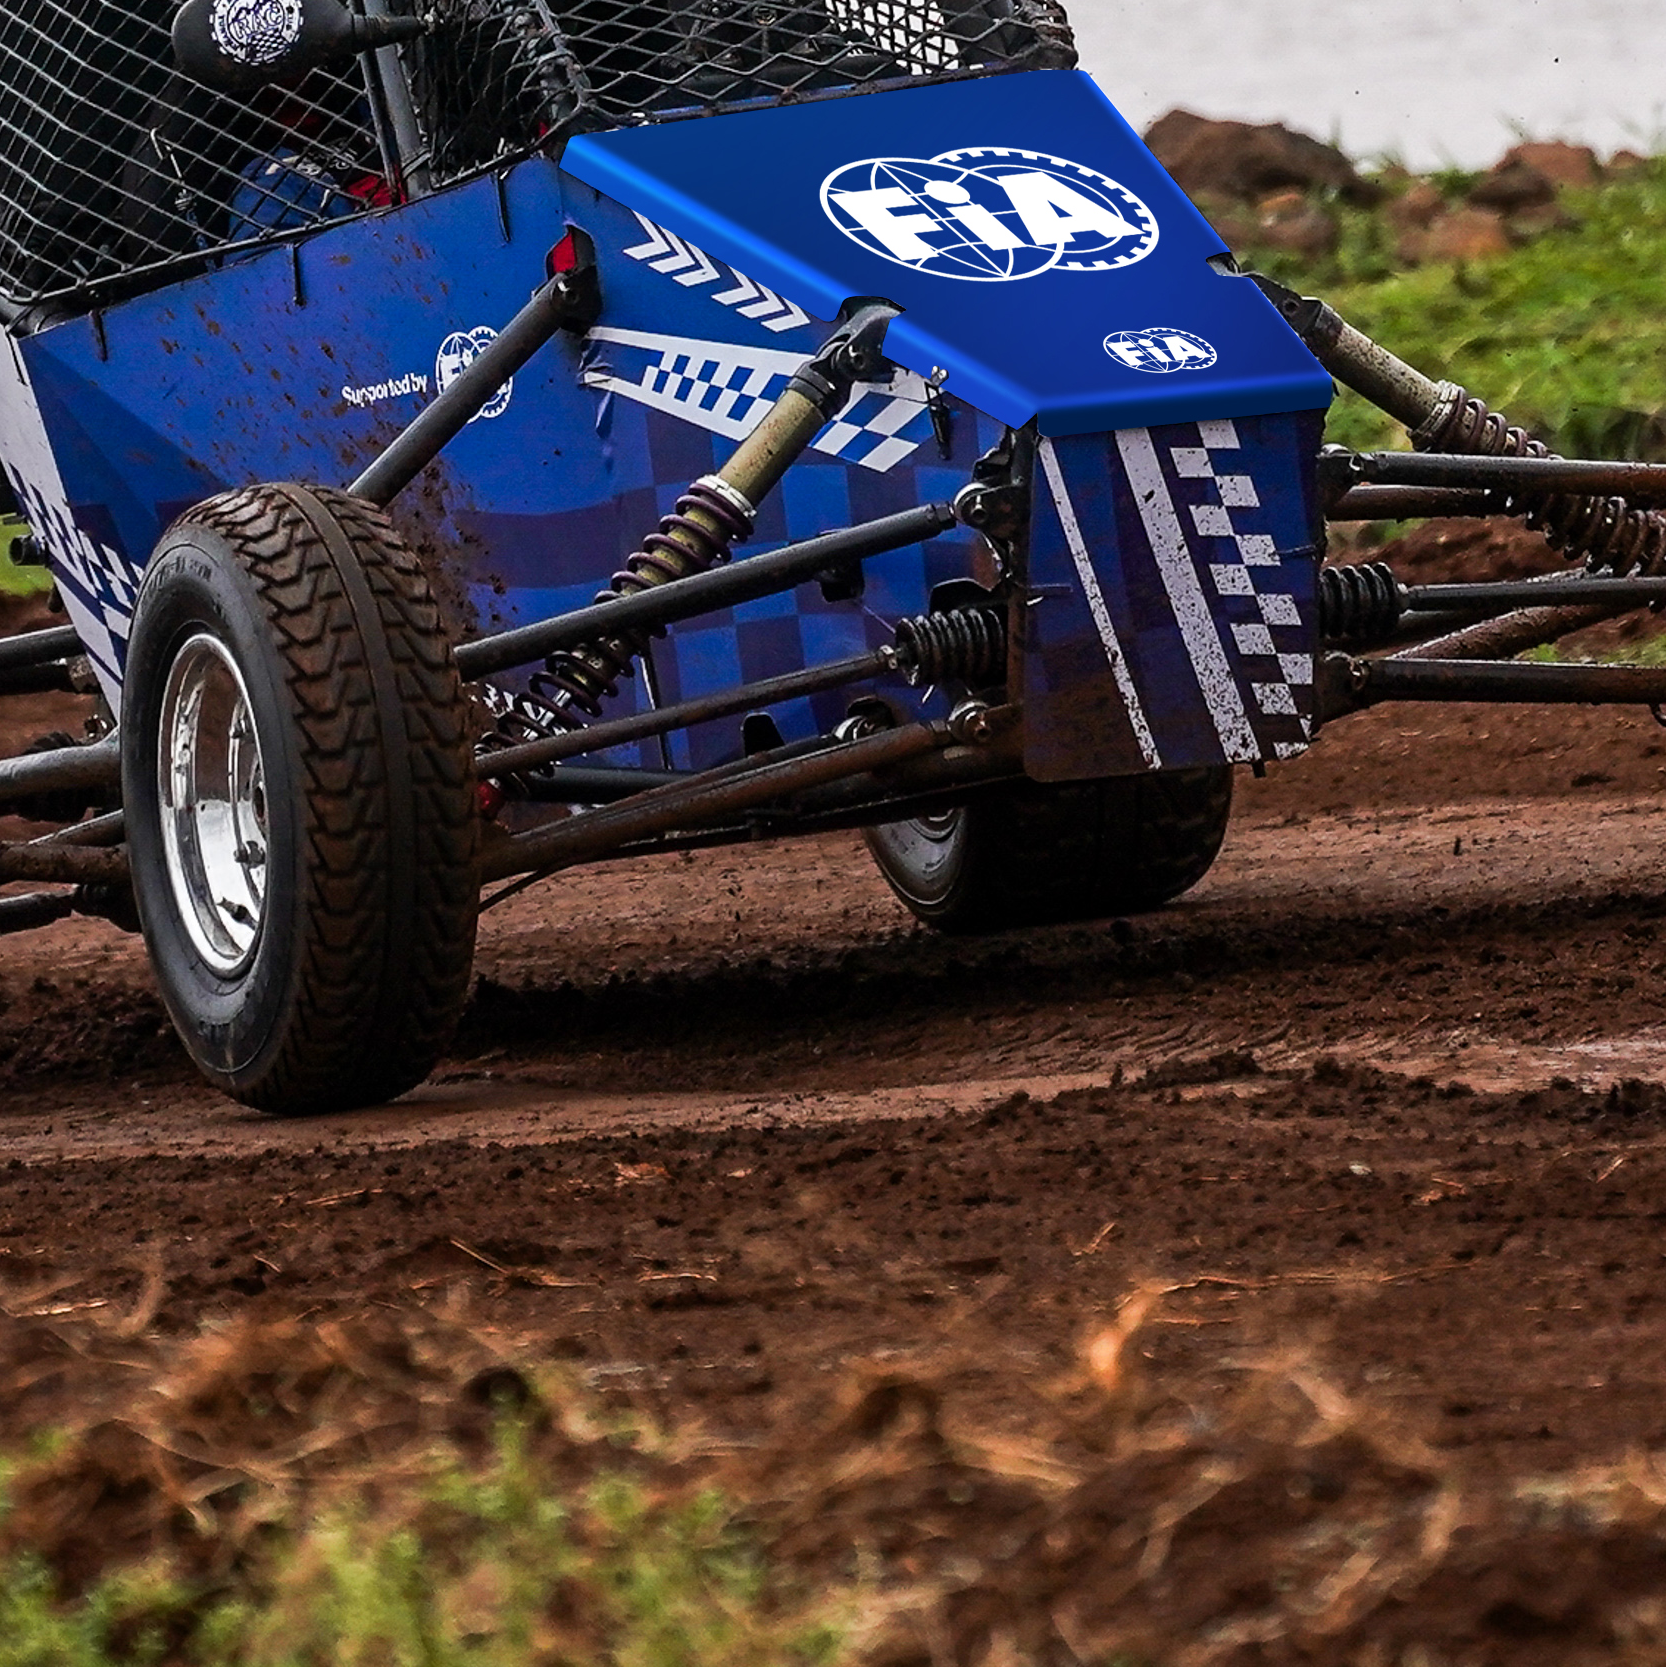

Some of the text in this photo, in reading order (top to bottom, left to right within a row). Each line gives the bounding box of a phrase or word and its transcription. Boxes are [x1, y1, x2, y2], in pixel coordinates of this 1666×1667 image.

[232, 8, 282, 39] RAC
[342, 373, 428, 407] Supported by
